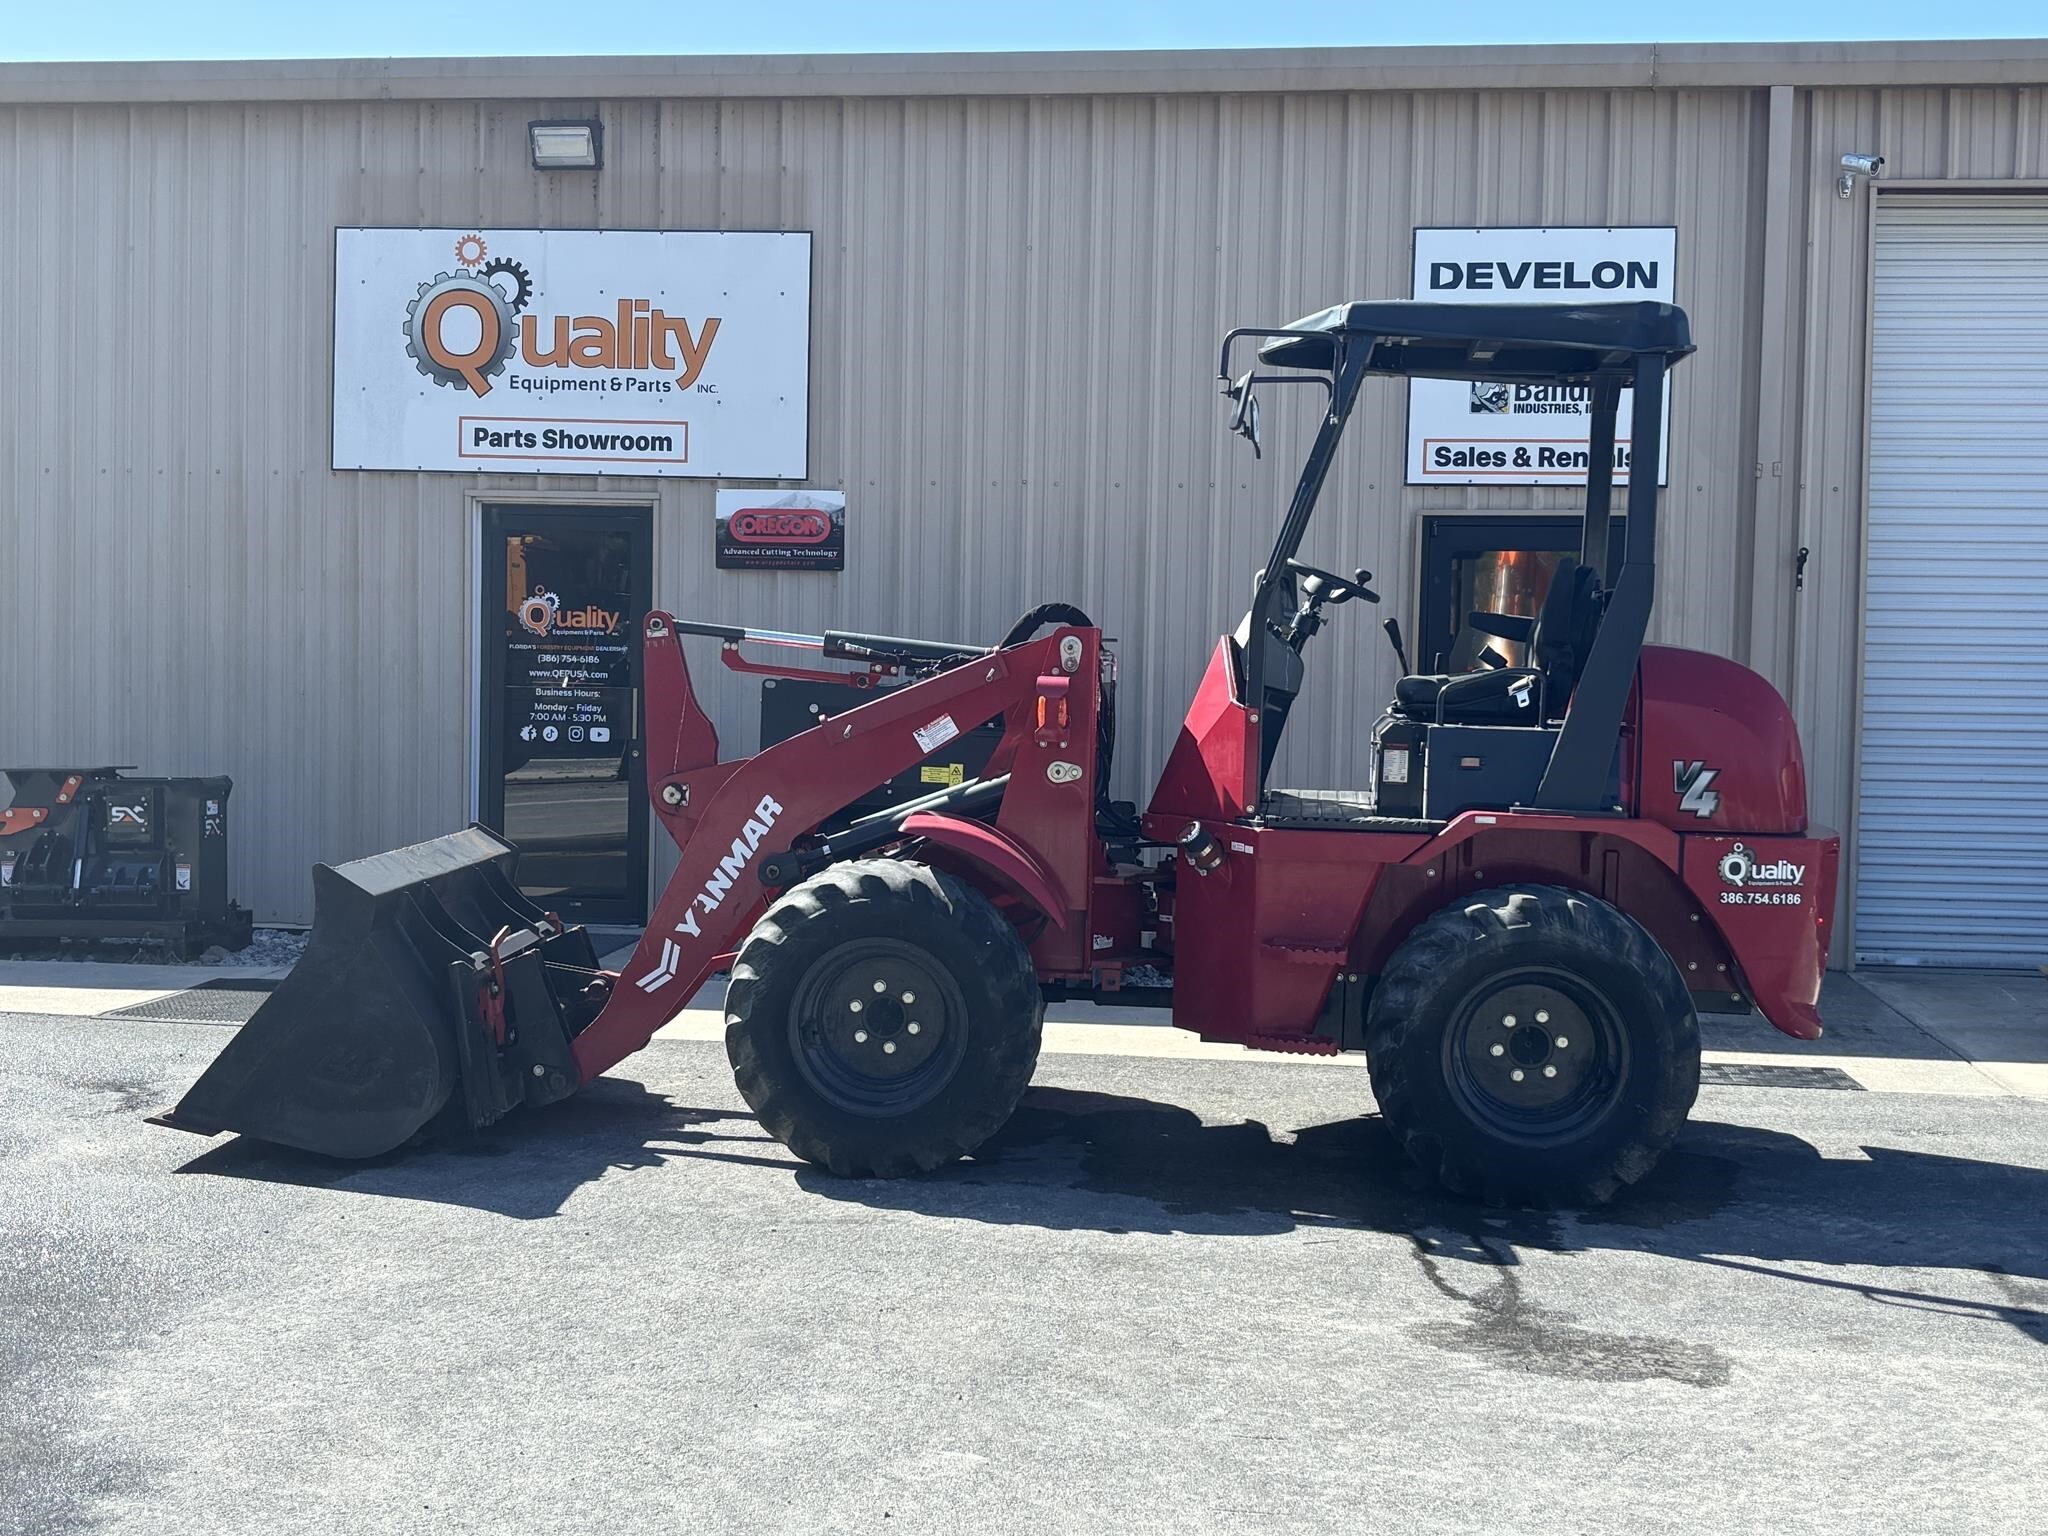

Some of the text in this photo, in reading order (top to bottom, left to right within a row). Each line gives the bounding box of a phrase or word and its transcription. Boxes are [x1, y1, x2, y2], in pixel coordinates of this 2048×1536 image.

[1429, 261, 1659, 290] DEVELON
[421, 288, 722, 399] Quality
[509, 375, 719, 394] Equipment & Parts INC.
[1513, 403, 1583, 416] INDUSTRIES,
[473, 426, 673, 452] Parts Showroom
[1433, 446, 1632, 468] Sales & Renl
[741, 516, 819, 536] OREGON
[723, 548, 838, 558] Advanced Cutting Technology
[525, 602, 620, 638] Quality
[537, 654, 600, 664] (386) 754-6186
[529, 669, 609, 679] www.QEPUSA.com
[535, 688, 601, 698] Business Hours:
[529, 713, 550, 721] 7:00
[551, 713, 567, 721] AM
[572, 713, 592, 722] 5:30
[593, 714, 607, 722] PM
[534, 703, 568, 712] Monday
[576, 704, 602, 713] Friday
[1672, 760, 1722, 819] V4
[674, 794, 784, 938] YANMAR
[1723, 857, 1806, 887] Quality
[1720, 892, 1801, 905] 386.754.6186
